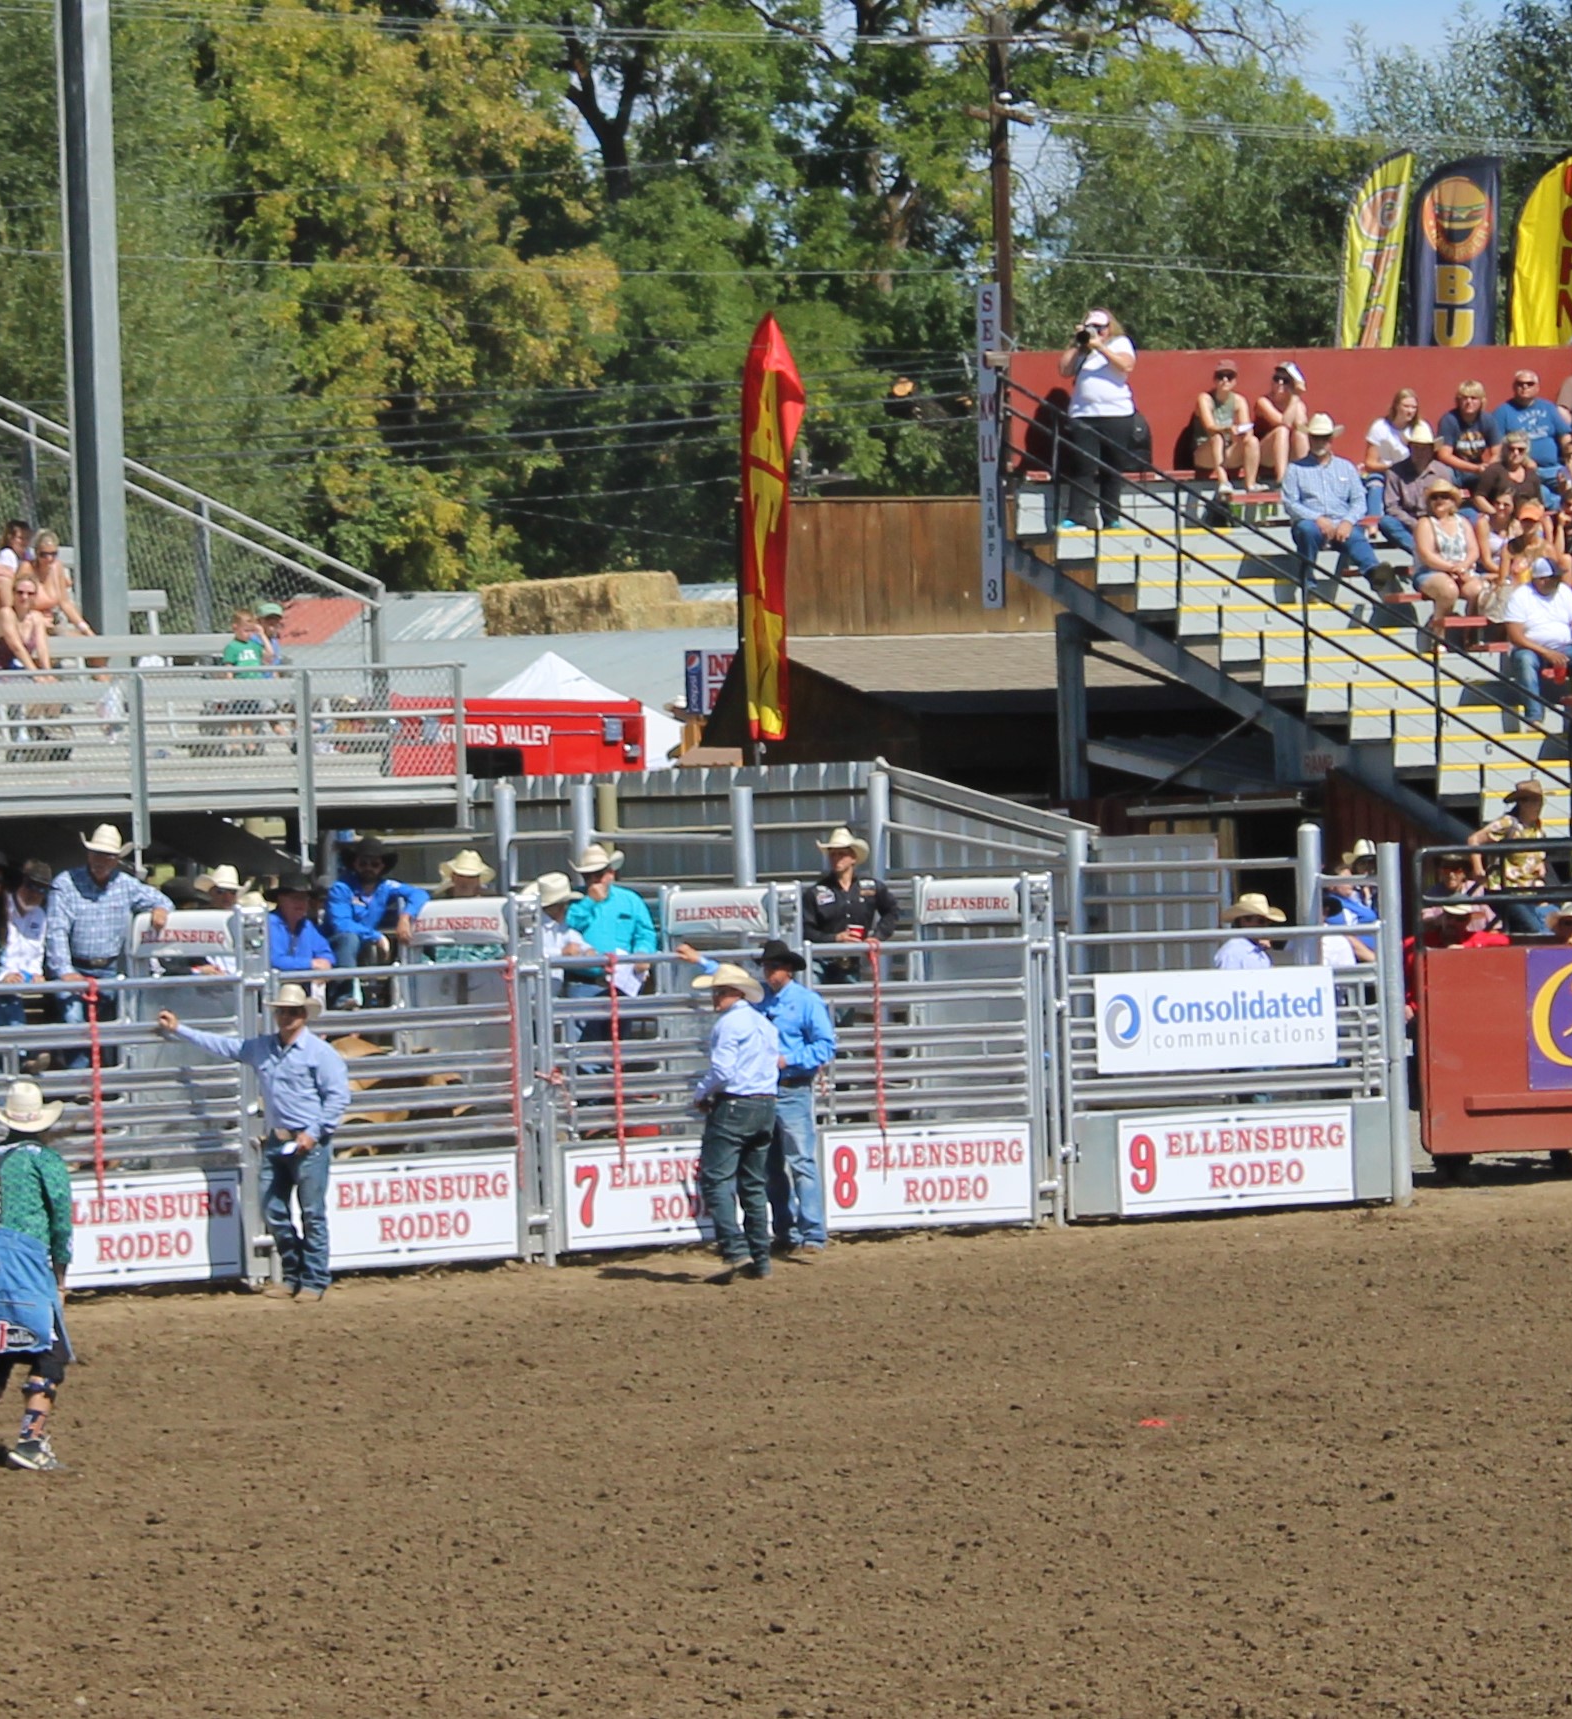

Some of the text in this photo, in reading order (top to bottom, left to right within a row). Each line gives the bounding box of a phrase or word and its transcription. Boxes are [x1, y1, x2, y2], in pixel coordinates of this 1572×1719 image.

[987, 579, 998, 602] 3
[438, 724, 551, 745] KITITAS VALLEY
[675, 905, 760, 921] ELLENSBURG
[926, 896, 1011, 911] ELLENSBURG
[140, 928, 226, 945] ELLENSBURG
[415, 916, 500, 933] ELLENSBURG
[1152, 986, 1324, 1025] Consolidated
[1153, 1024, 1326, 1049] communications
[833, 1138, 1024, 1209] 8 ELLENSBURG
[1129, 1122, 1346, 1194] 9 ELLENSBURG
[904, 1174, 989, 1204] RODEO
[1209, 1159, 1304, 1190] RODEO
[336, 1172, 510, 1210] ELLENSBURG
[574, 1164, 600, 1228] 7
[71, 1188, 234, 1226] LLENSBURG
[378, 1210, 472, 1244] RODEO
[96, 1229, 194, 1264] RODEO
